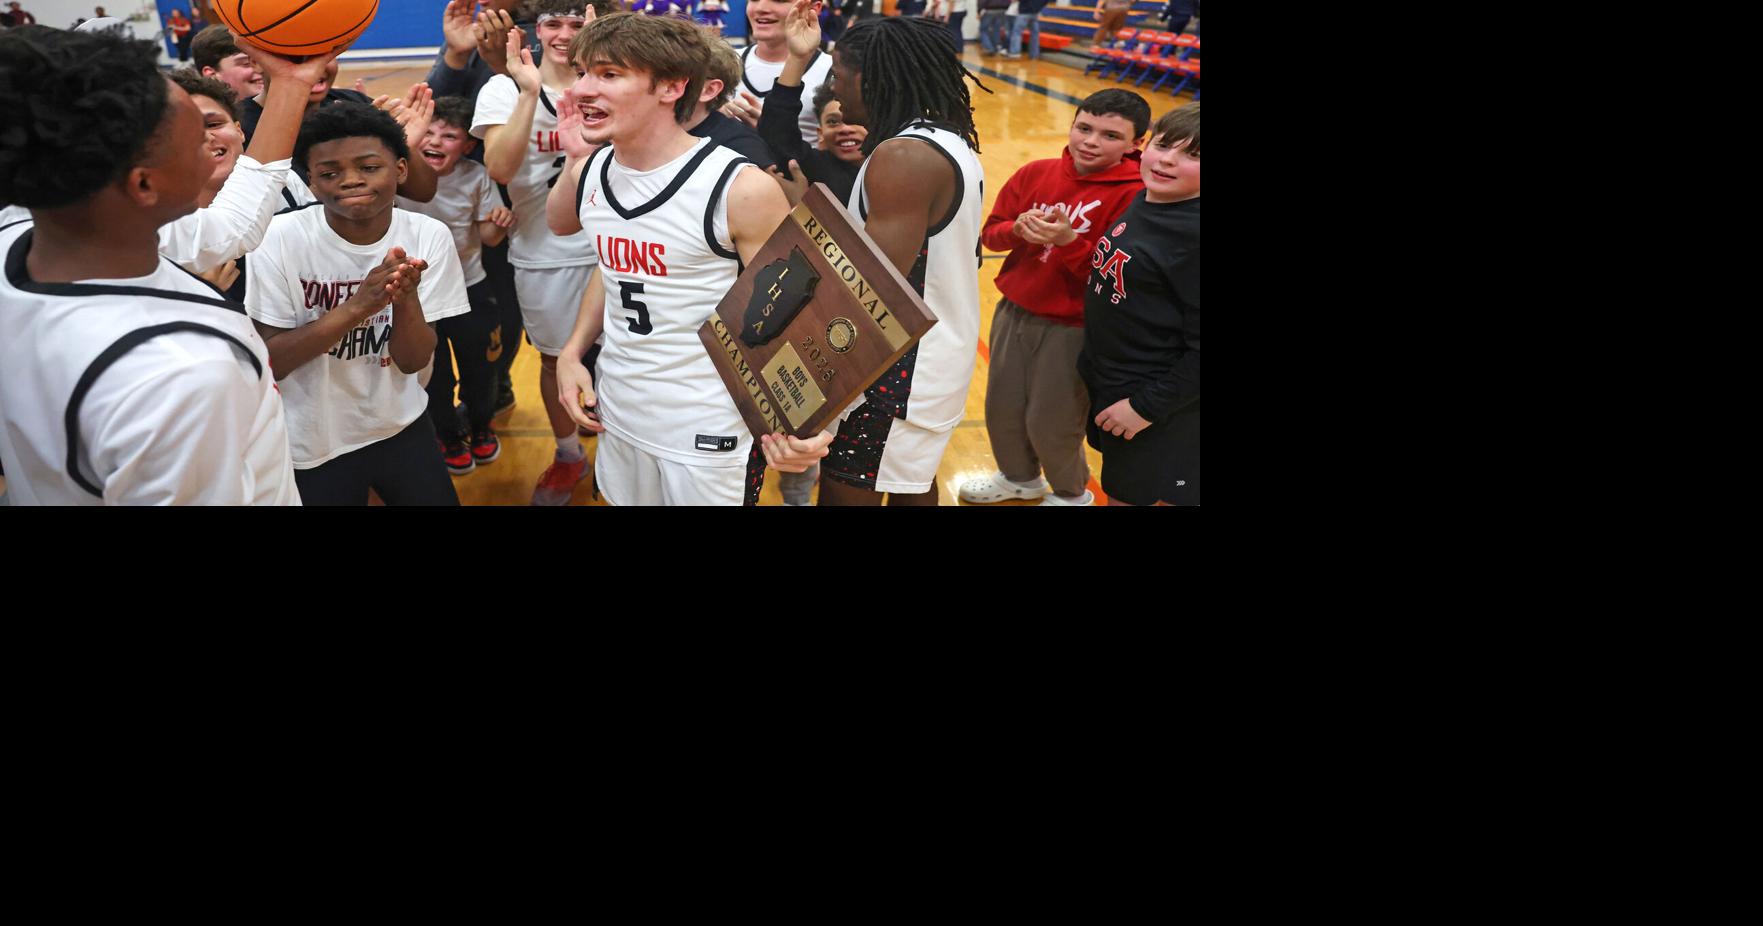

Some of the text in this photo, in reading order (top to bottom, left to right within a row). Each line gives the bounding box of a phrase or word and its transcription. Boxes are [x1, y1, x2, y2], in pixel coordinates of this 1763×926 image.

[597, 235, 667, 276] LIONS
[803, 216, 889, 331] REGIONAL
[618, 280, 653, 335] 5
[714, 319, 785, 435] CHAMPION
[792, 366, 808, 388] BOYS
[802, 336, 836, 382] 2026
[771, 381, 792, 413] CLASS 1A
[777, 365, 806, 409] BASKETBALL
